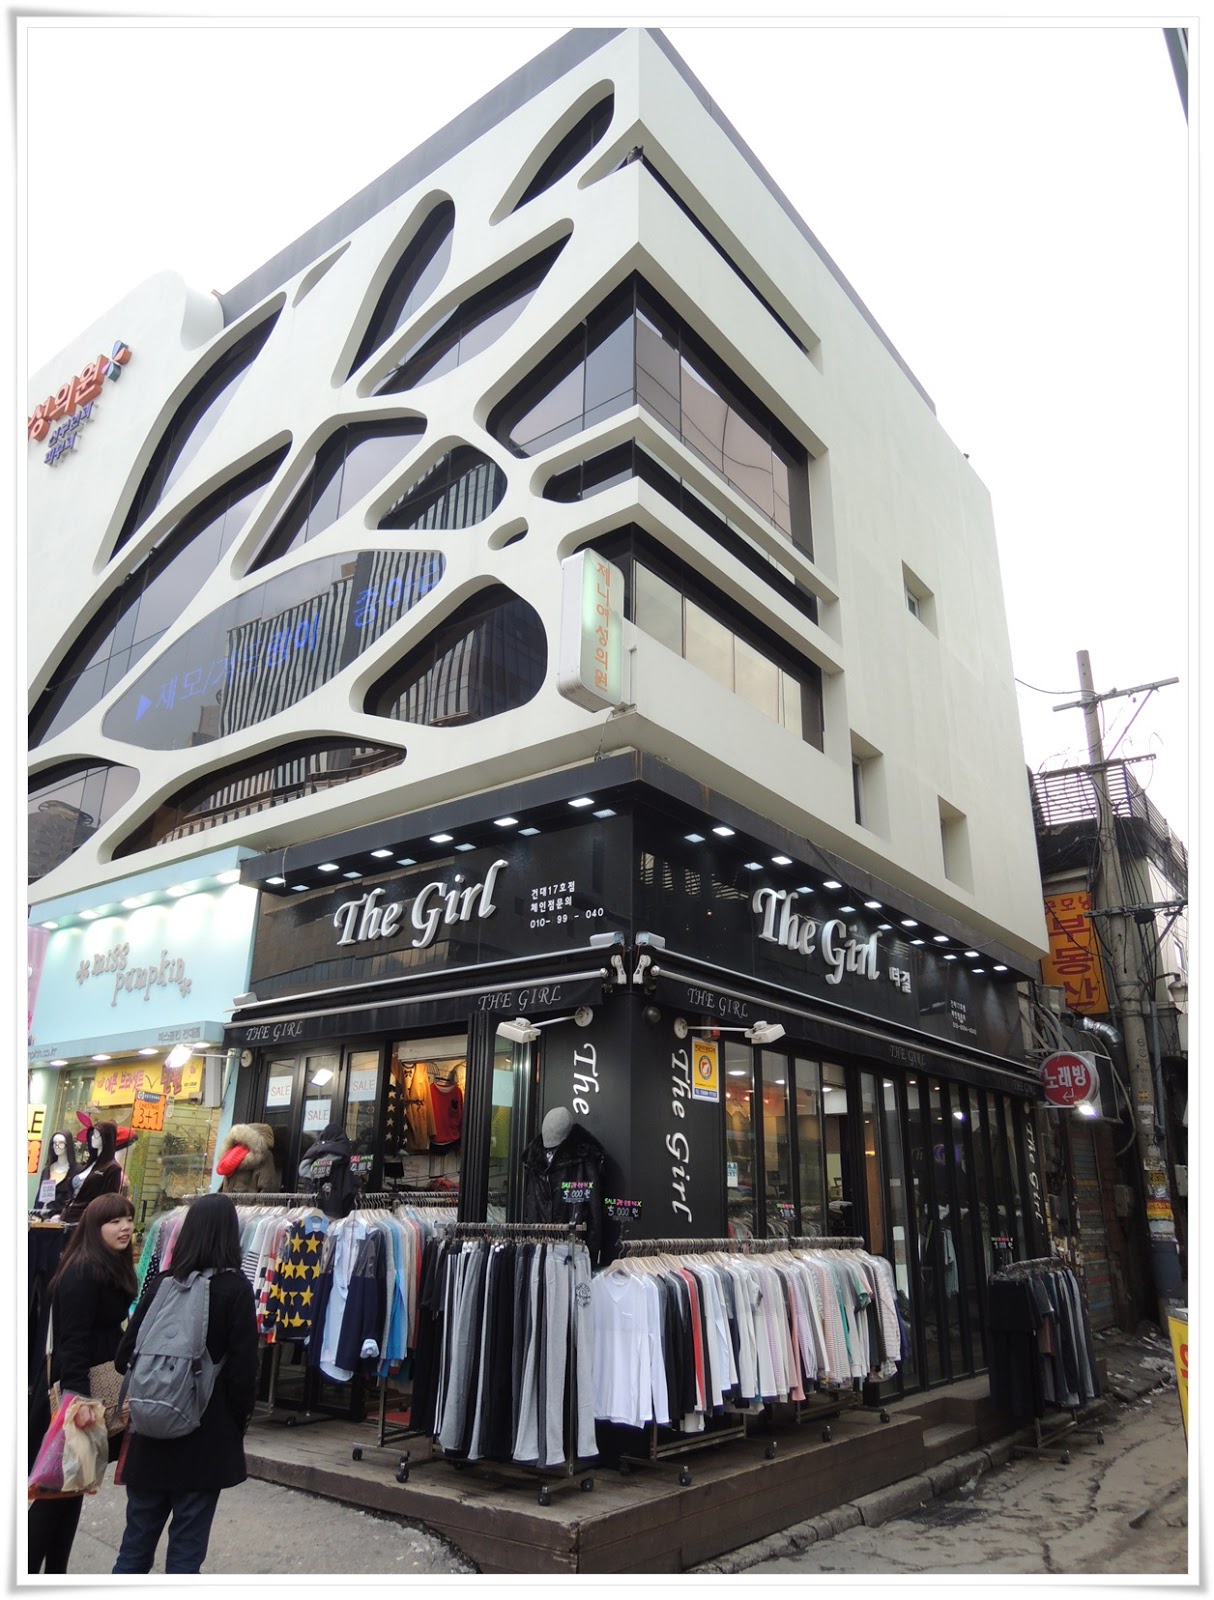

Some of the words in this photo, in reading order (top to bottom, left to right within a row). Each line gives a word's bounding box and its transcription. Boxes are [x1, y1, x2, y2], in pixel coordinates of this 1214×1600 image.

[595, 562, 611, 692] 제니여성의원
[334, 887, 401, 946] The
[411, 859, 508, 948] Girl
[530, 896, 572, 912] 체인점문의
[531, 880, 575, 900] 건대17호점
[752, 888, 817, 955] The
[821, 919, 883, 985] Girl
[92, 943, 130, 976] miss
[1049, 914, 1098, 1008] 부동산
[111, 950, 187, 1007] pumpkin
[477, 992, 512, 1011] THE
[518, 985, 562, 1011] GIRL
[687, 987, 715, 1009] THE
[718, 996, 749, 1019] GIRL
[246, 1025, 270, 1041] THE
[272, 1020, 303, 1042] GIRL
[271, 1085, 291, 1097] SALE
[352, 1079, 376, 1092] SALE
[573, 1043, 600, 1115] The
[671, 1049, 692, 1119] The
[1044, 1065, 1087, 1089] 노래방
[137, 1107, 160, 1125] 3+1
[307, 1109, 330, 1121] SALE
[666, 1132, 692, 1223] Girl
